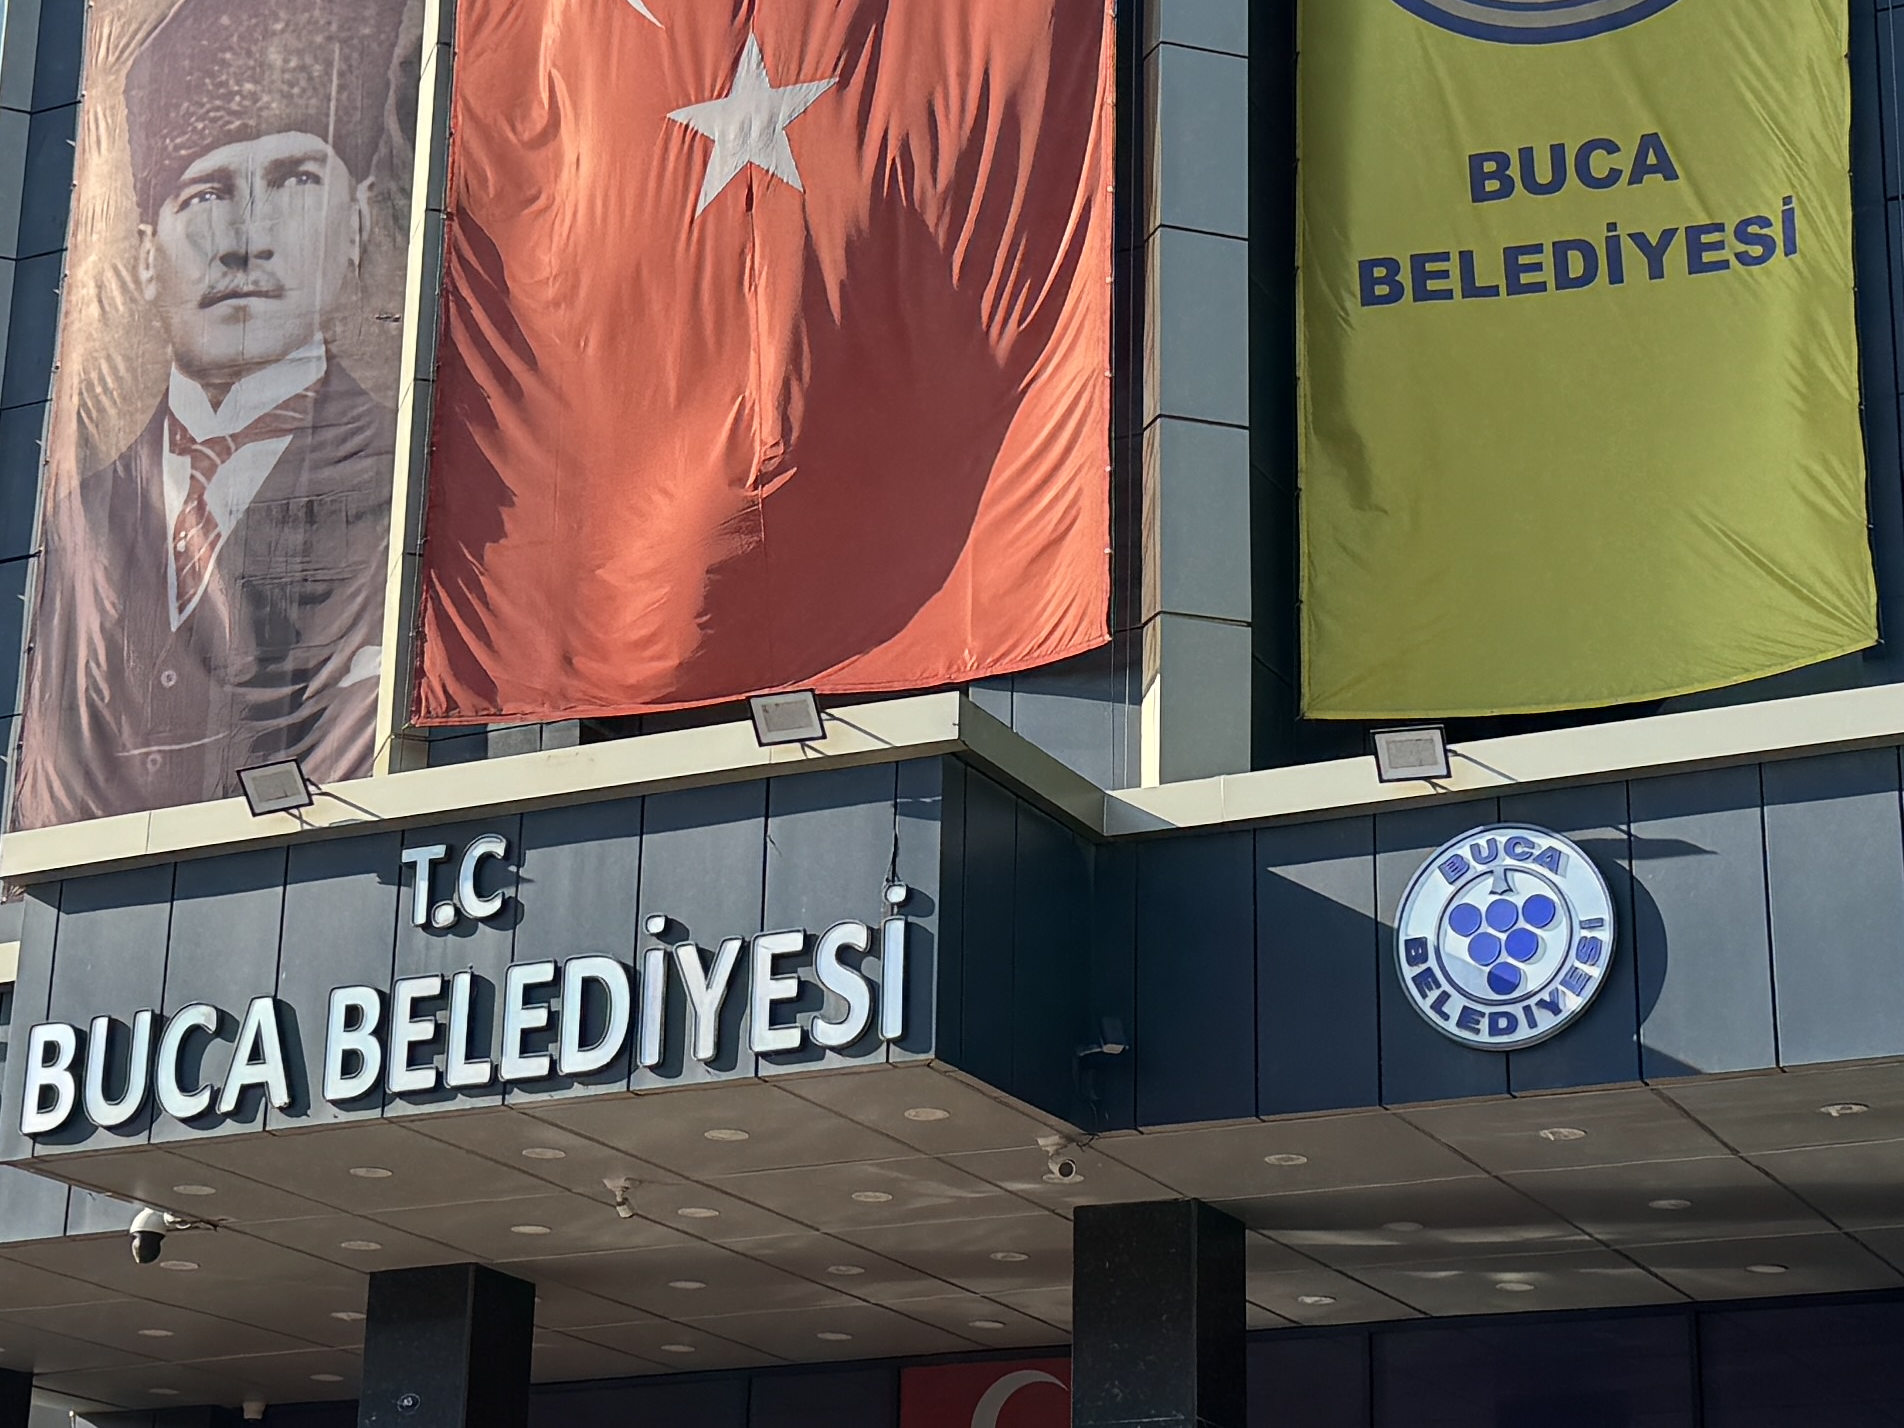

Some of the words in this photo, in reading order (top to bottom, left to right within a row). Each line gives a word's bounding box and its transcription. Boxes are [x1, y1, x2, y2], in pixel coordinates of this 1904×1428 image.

[1468, 132, 1679, 204] BUCA
[1358, 195, 1799, 308] BELEDİYESİ
[401, 833, 507, 927] T.C
[1437, 835, 1570, 886] BUCA
[20, 995, 292, 1135] BUCA
[322, 882, 907, 1102] BELEDİYESİ
